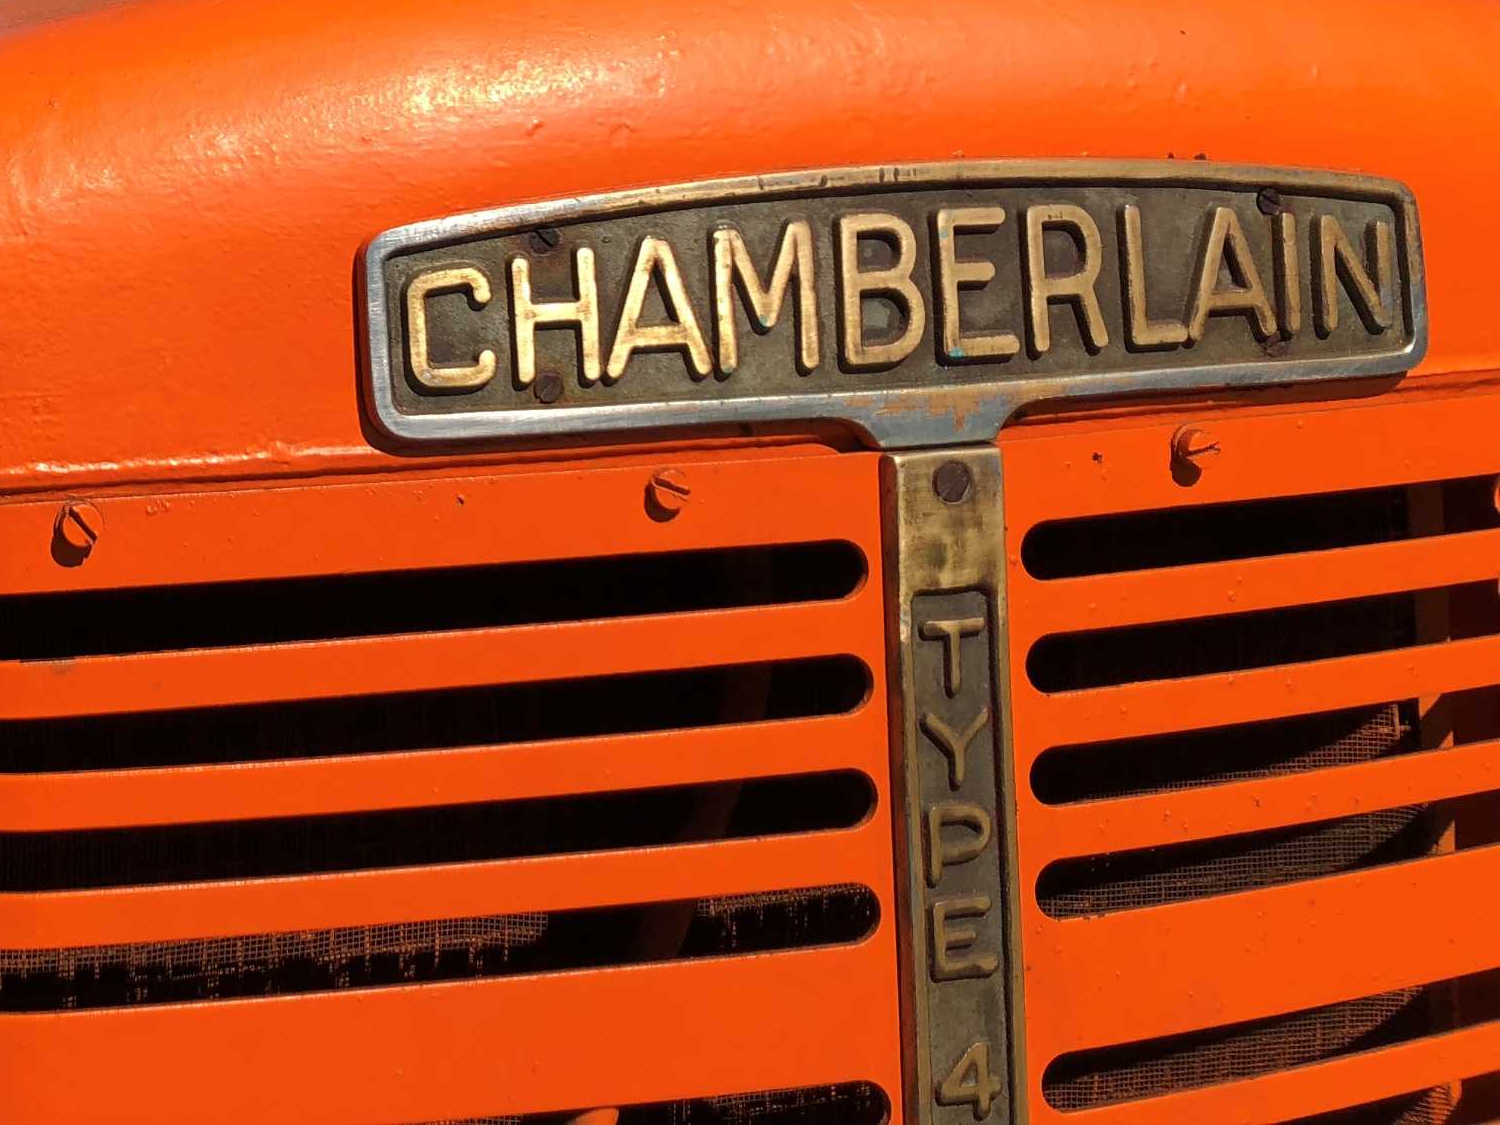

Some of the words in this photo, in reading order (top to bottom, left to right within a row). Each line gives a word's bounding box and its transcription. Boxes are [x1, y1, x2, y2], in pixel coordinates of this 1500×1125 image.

[404, 203, 1391, 391] CHAMBERLAIN
[920, 617, 999, 982] TYPE
[936, 1042, 1001, 1121] 4
